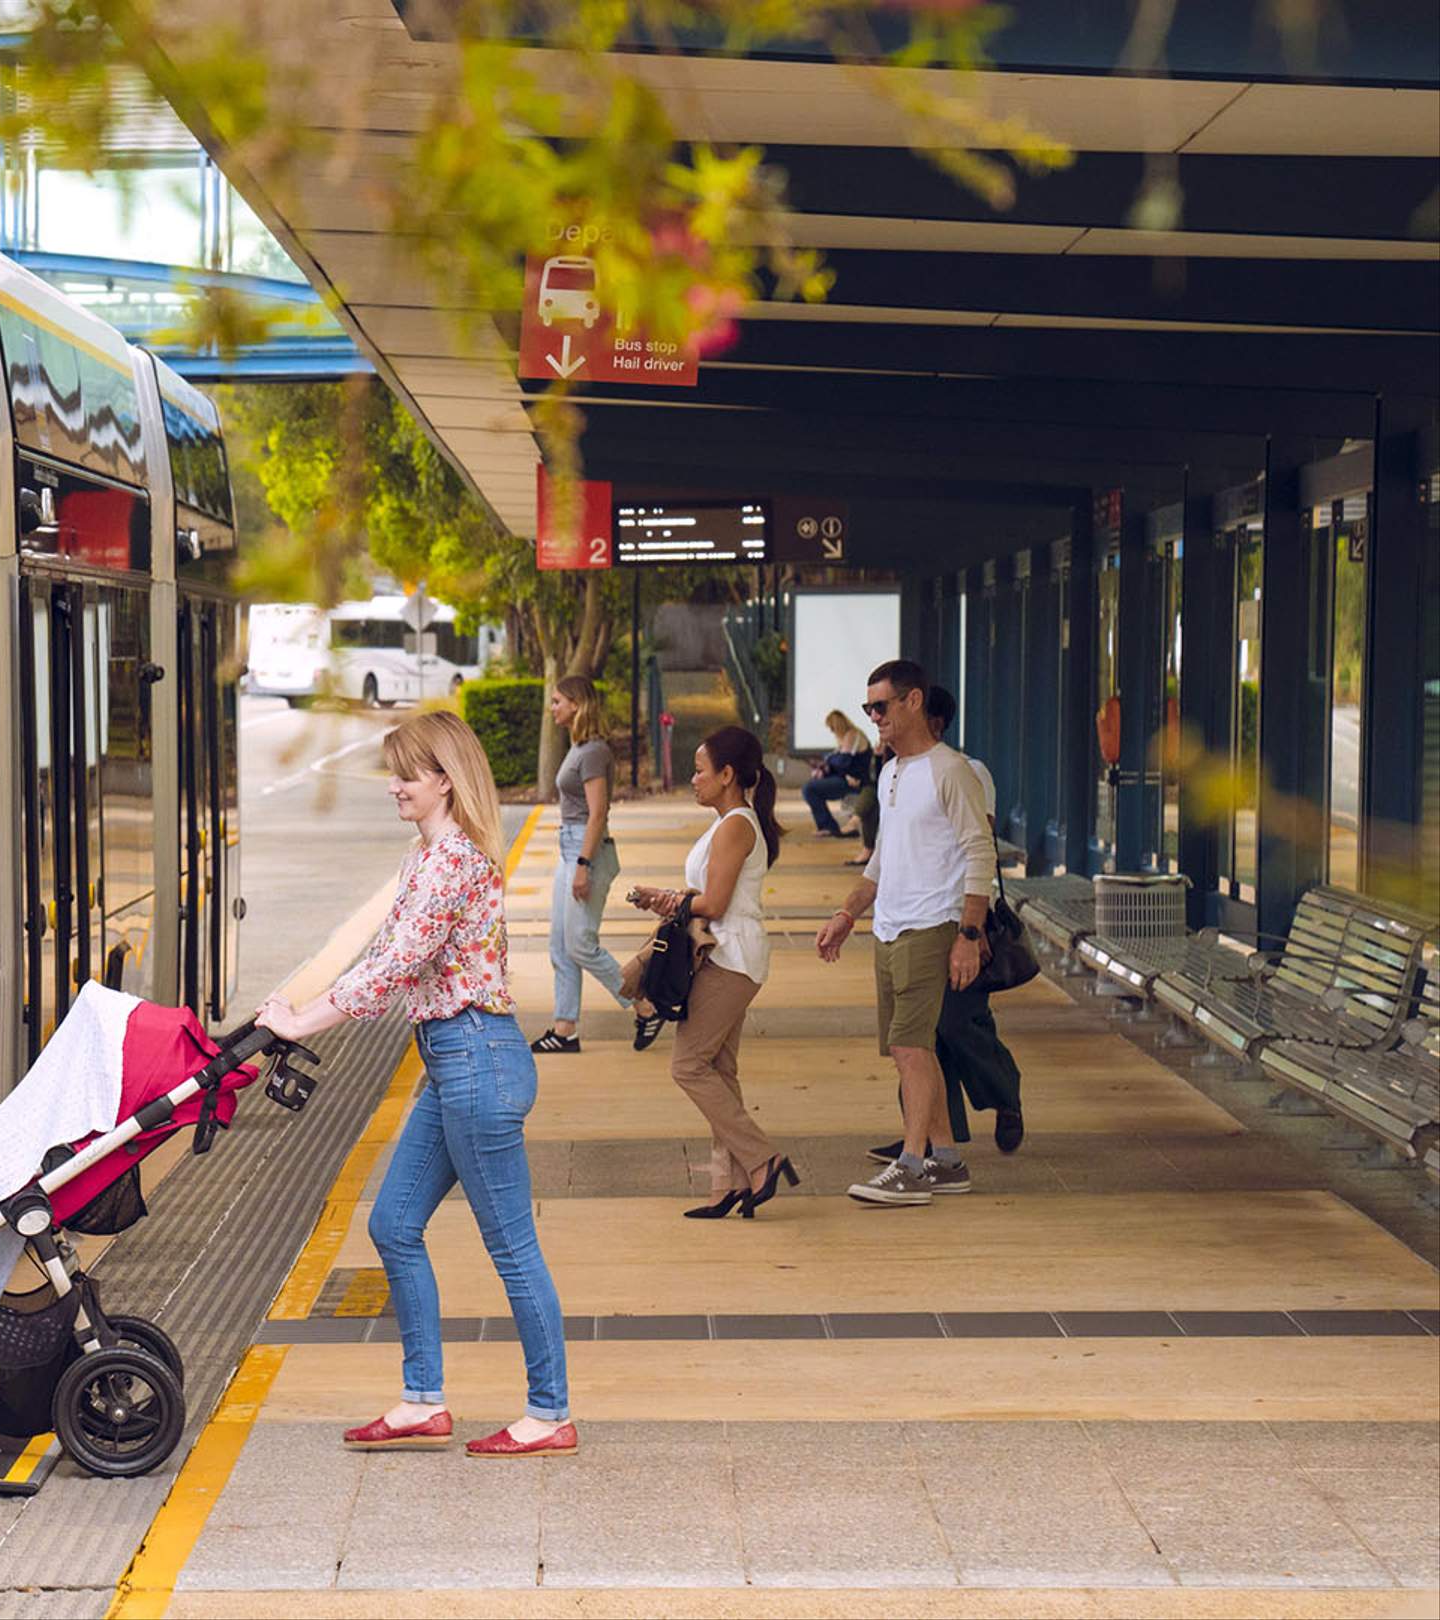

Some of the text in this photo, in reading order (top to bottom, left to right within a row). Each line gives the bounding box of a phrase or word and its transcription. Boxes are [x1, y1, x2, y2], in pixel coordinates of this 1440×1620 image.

[614, 338, 678, 356] Bus stop
[613, 355, 685, 371] Hail driver
[589, 537, 609, 564] 2
